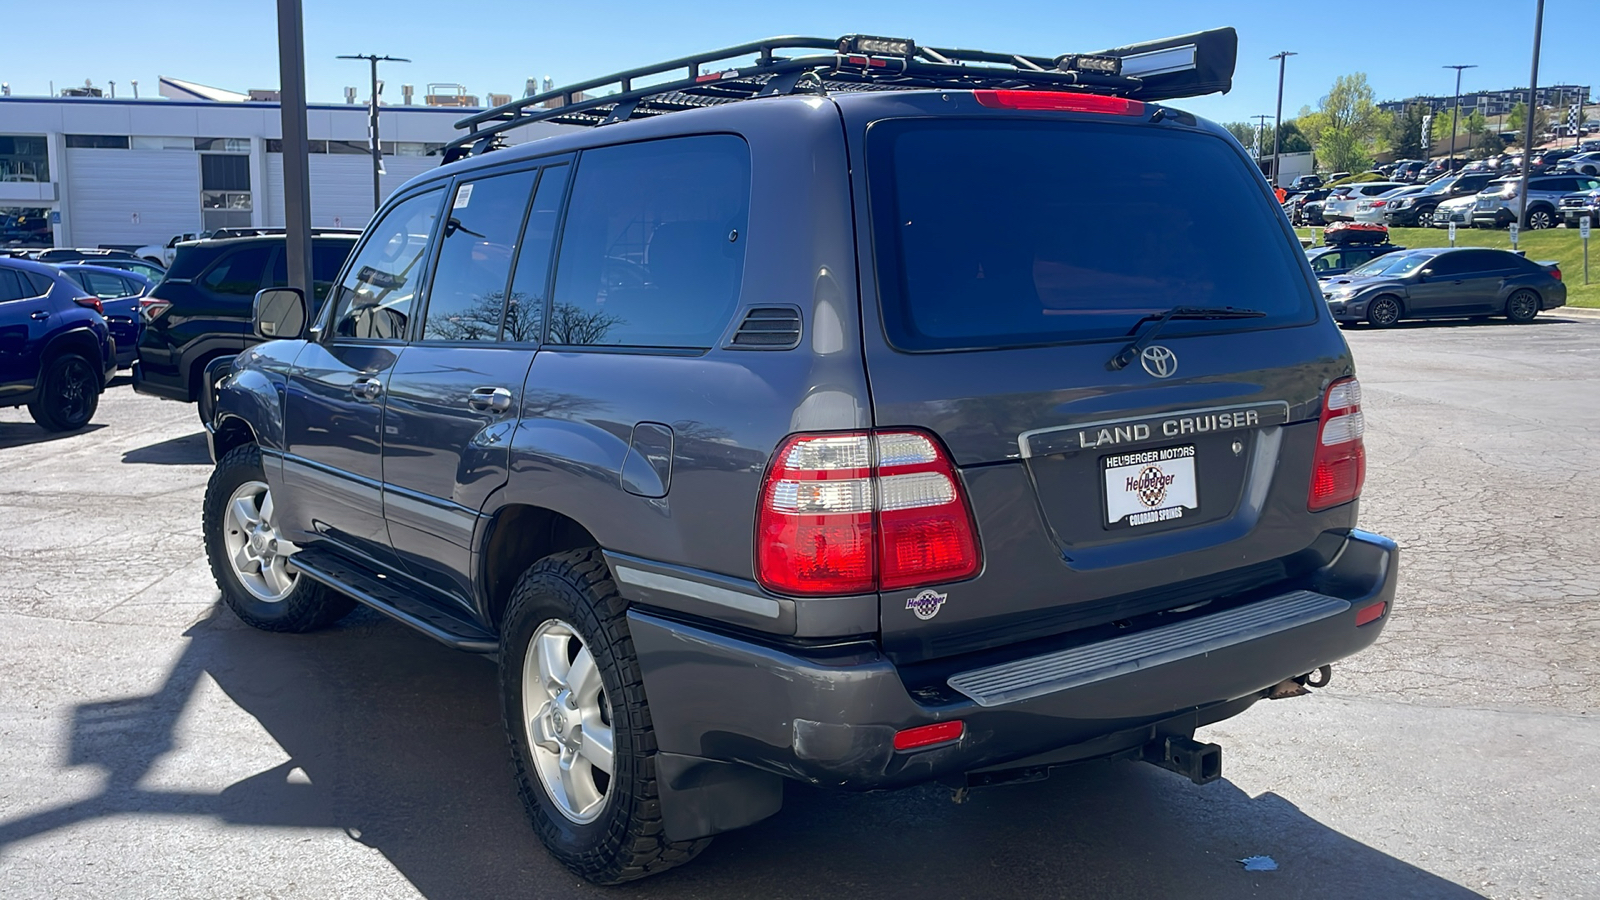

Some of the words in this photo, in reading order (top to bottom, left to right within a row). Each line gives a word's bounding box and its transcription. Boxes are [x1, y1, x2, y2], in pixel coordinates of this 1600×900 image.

[1079, 423, 1149, 448] LAND
[1162, 410, 1258, 436] CRUISER
[1106, 450, 1159, 467] HEUBERGER
[1160, 446, 1195, 460] MOTORS
[1125, 474, 1175, 492] Heuberger
[1129, 511, 1159, 526] COLORADO
[1159, 507, 1183, 520] SPRINGS
